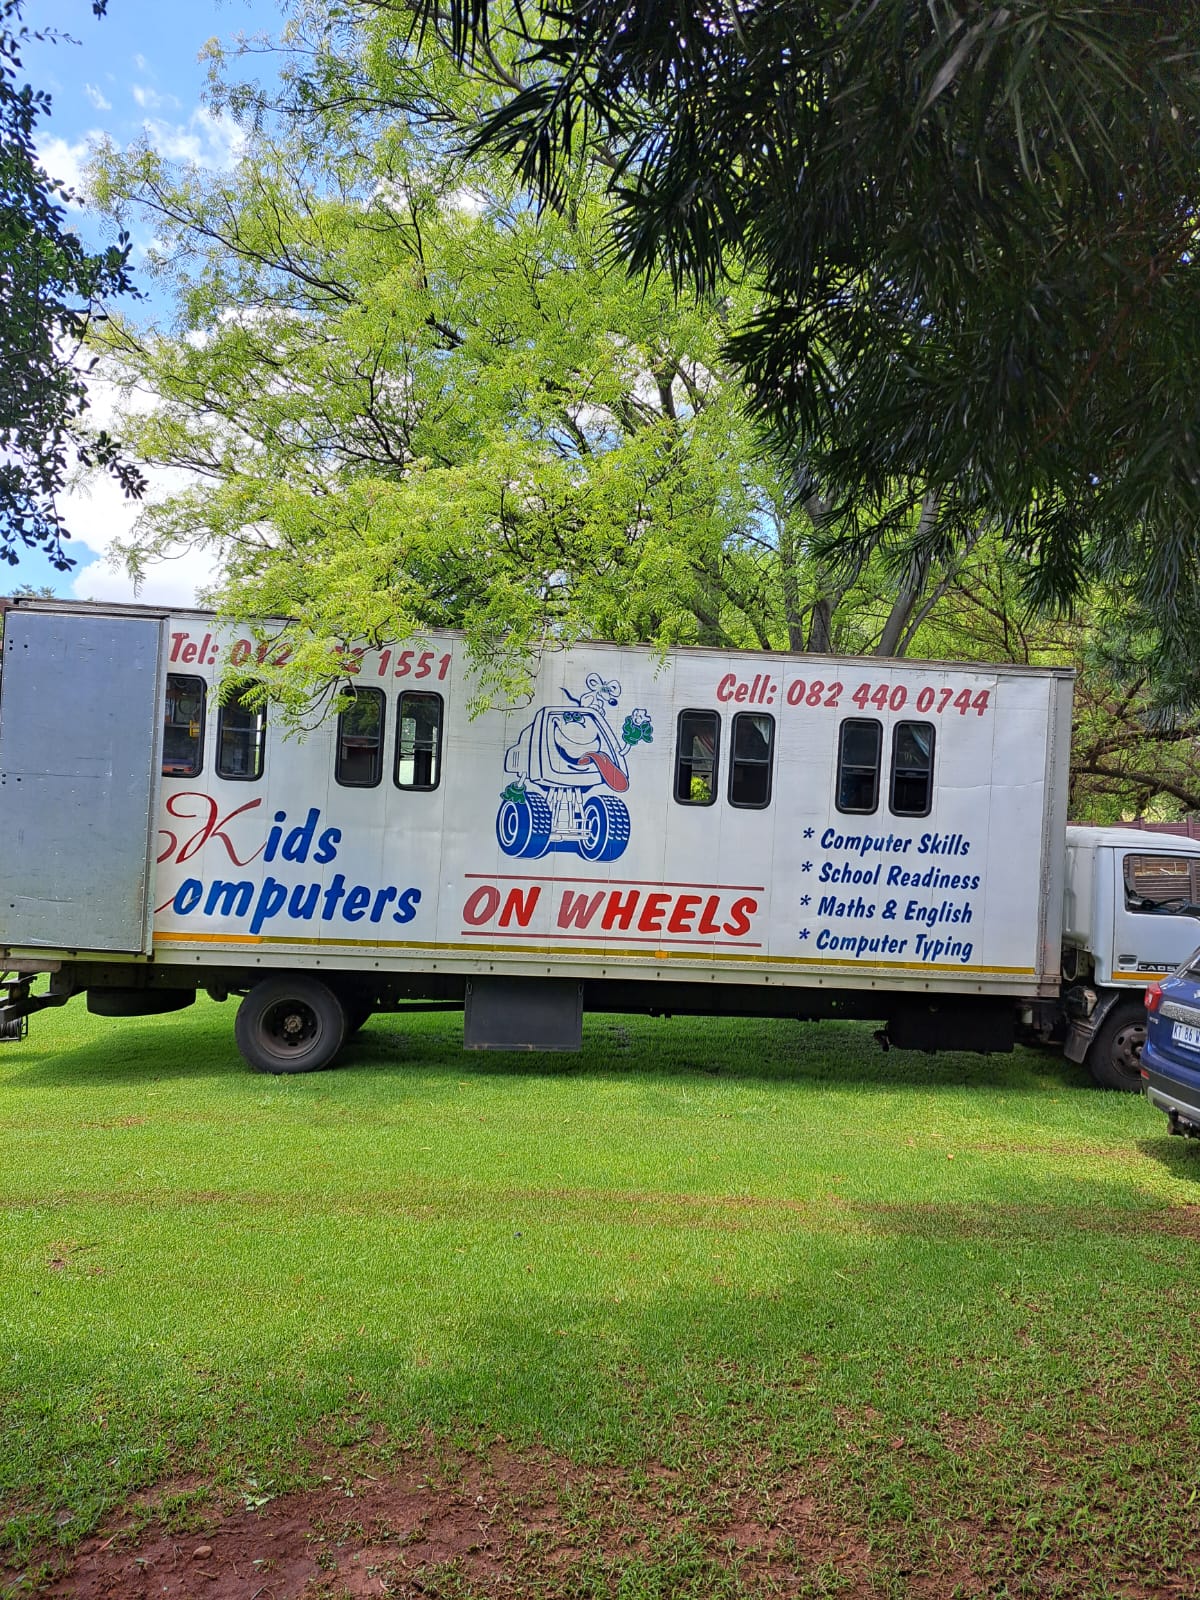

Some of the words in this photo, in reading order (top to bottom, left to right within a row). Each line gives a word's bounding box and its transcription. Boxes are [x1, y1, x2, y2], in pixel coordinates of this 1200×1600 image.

[170, 632, 219, 665] Tel:
[377, 649, 452, 680] 1551
[716, 673, 777, 705] Cell:
[786, 678, 844, 708] 082
[852, 682, 908, 712] 440
[916, 686, 991, 717] 0744
[166, 791, 342, 867] Kids
[820, 828, 912, 857] Computer
[917, 833, 970, 856] Skills
[818, 861, 883, 886] School
[886, 864, 980, 890] Readiness
[154, 870, 422, 936] omputers
[462, 885, 541, 928] ON
[556, 889, 758, 936] WHEELS
[817, 895, 876, 919] Maths
[881, 899, 897, 920] &
[904, 900, 973, 928] English
[815, 928, 908, 956] Computer
[914, 933, 974, 963] Typing
